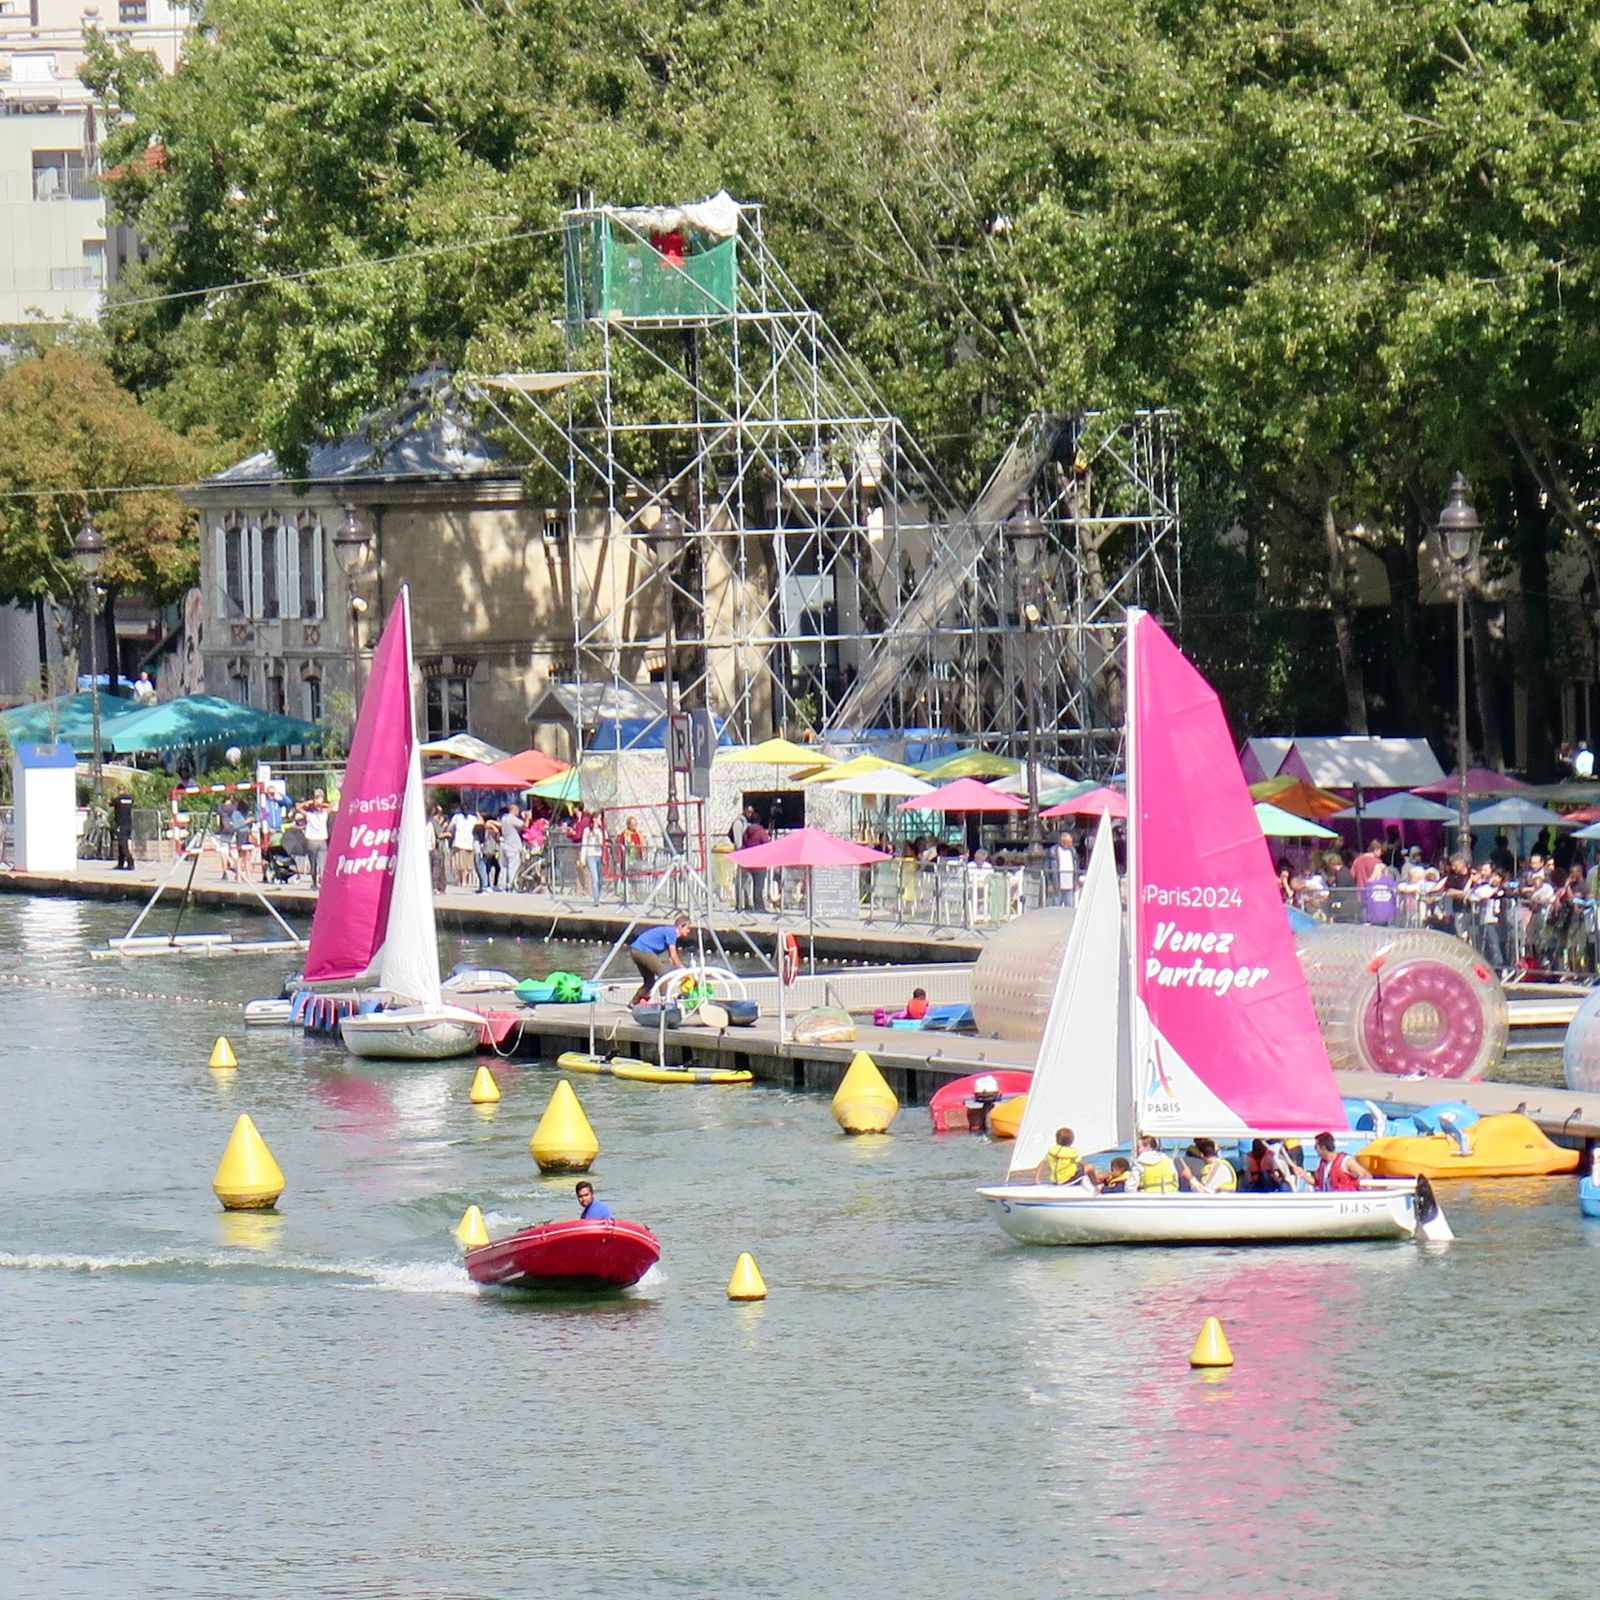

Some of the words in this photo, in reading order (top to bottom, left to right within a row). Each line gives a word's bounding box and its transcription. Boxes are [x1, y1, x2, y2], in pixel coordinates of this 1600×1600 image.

[1153, 921, 1235, 954] Venez
[1145, 957, 1270, 997] Partager
[1147, 1102, 1182, 1114] PARIS
